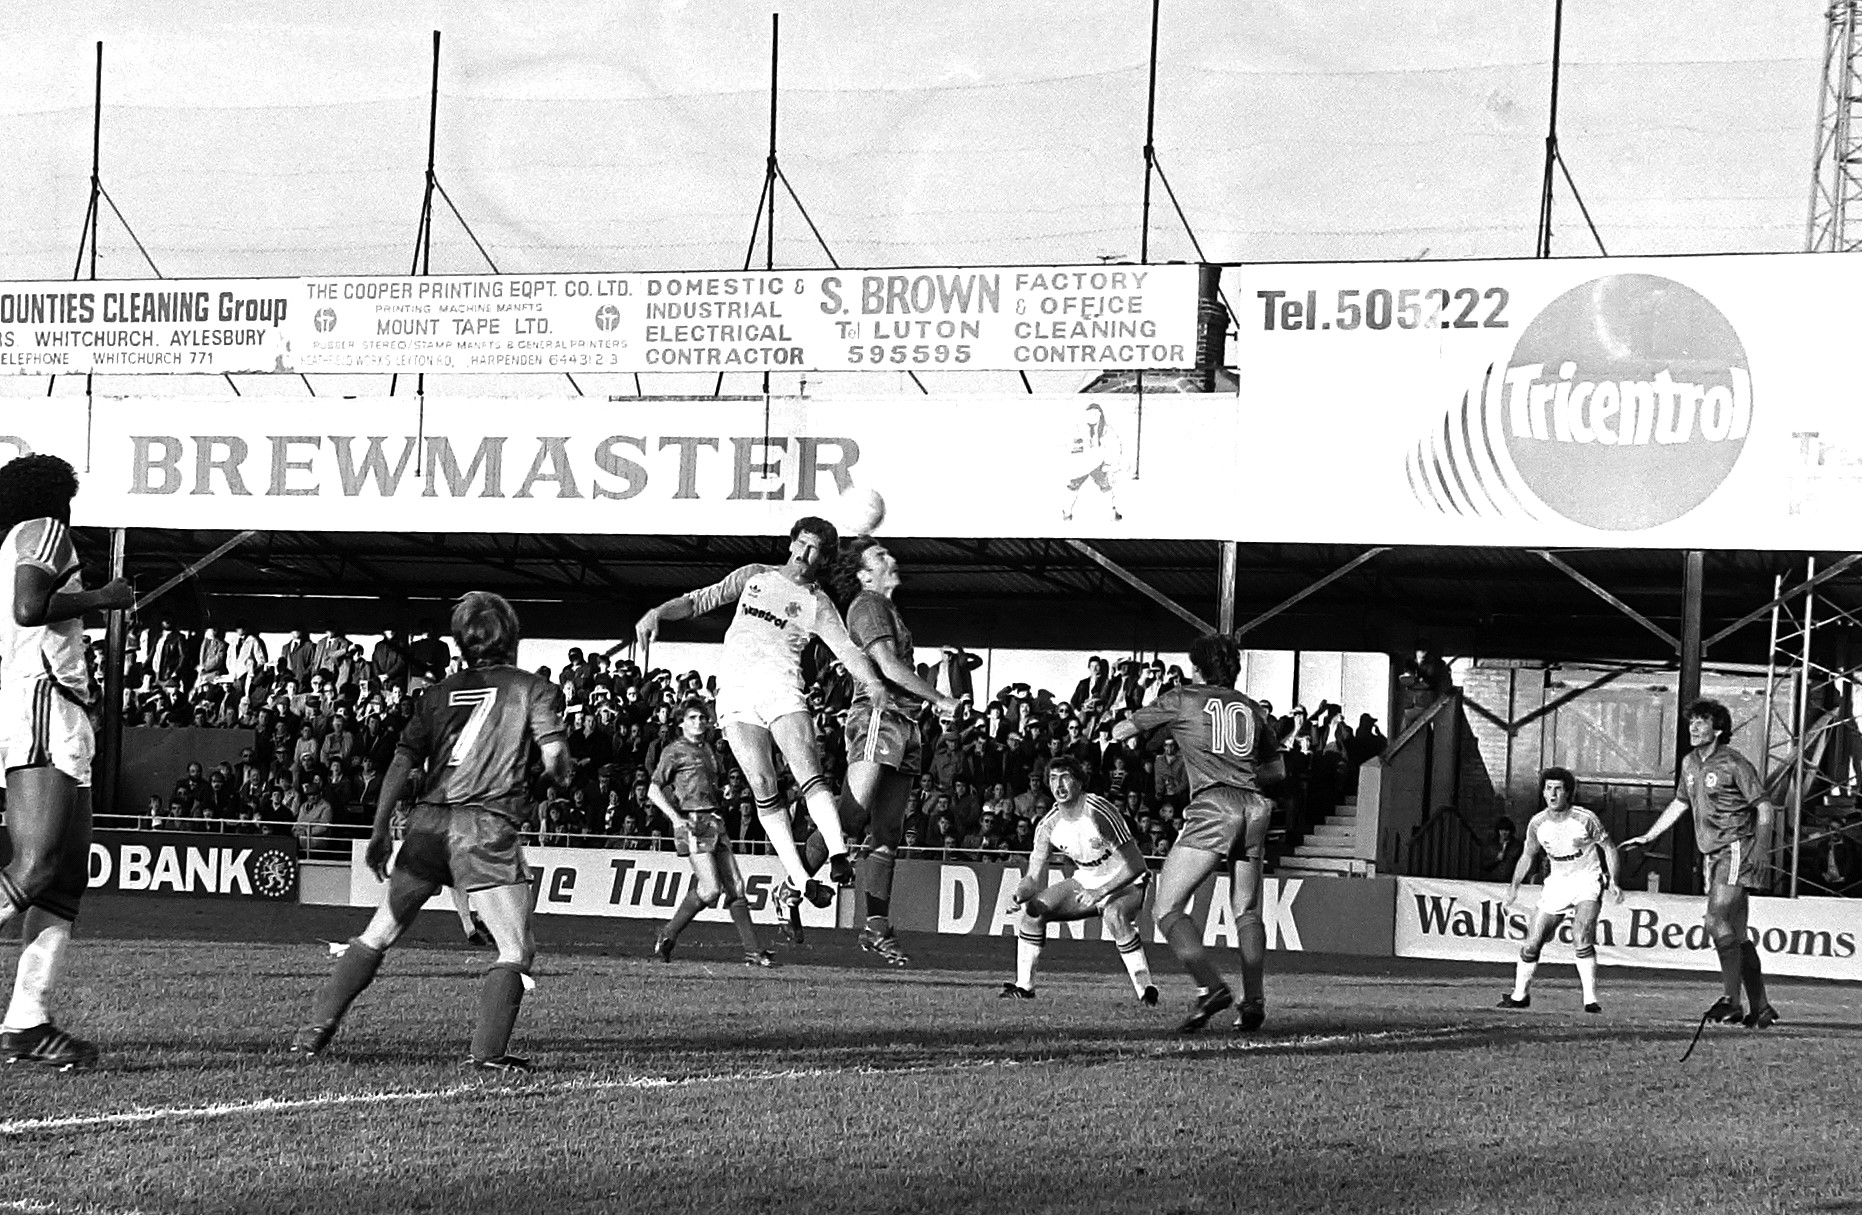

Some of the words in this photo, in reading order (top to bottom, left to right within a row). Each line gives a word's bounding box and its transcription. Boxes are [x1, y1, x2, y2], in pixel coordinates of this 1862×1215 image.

[307, 283, 338, 300] THE
[344, 283, 412, 299] COOPER
[419, 281, 503, 299] PRINTING
[510, 281, 557, 299] EQPT.
[565, 280, 592, 297] CO.
[598, 280, 632, 296] LTD.
[647, 277, 783, 296] DOMESTIC
[794, 278, 804, 295] &
[1016, 272, 1148, 291] FACTORY
[820, 277, 849, 315] S.
[861, 274, 1000, 314] BROWN
[103, 292, 209, 323] CLEANING
[218, 292, 287, 328] Group
[376, 305, 431, 313] PRINTING
[439, 304, 491, 313] MACHINE
[646, 301, 782, 319] INDUSTRIAL
[1016, 299, 1026, 315] &
[1040, 296, 1142, 316] OFFICE
[377, 319, 440, 335] MOUNT
[452, 318, 500, 335] TAPE
[515, 318, 552, 334] LTD.
[646, 324, 792, 342] ELECTRICAL
[835, 321, 860, 339] Tel
[874, 320, 980, 339] LUTON
[1014, 320, 1156, 339] CLEANING
[170, 329, 266, 346] AYLESBURY
[93, 352, 181, 364] WHITCHURCH
[189, 352, 212, 364] 771
[471, 355, 542, 365] HARPENDEN
[646, 347, 804, 365] CONTRACTOR
[848, 345, 971, 364] 595595
[1014, 344, 1184, 363] CONTRACTOR
[1503, 361, 1753, 447] Tricentrol
[127, 435, 861, 501] BREWMASTER
[447, 687, 498, 766] 7
[1204, 699, 1254, 757] 10
[119, 844, 253, 895] BANK
[609, 858, 773, 911] Trus
[1414, 893, 1615, 947] Wallsan
